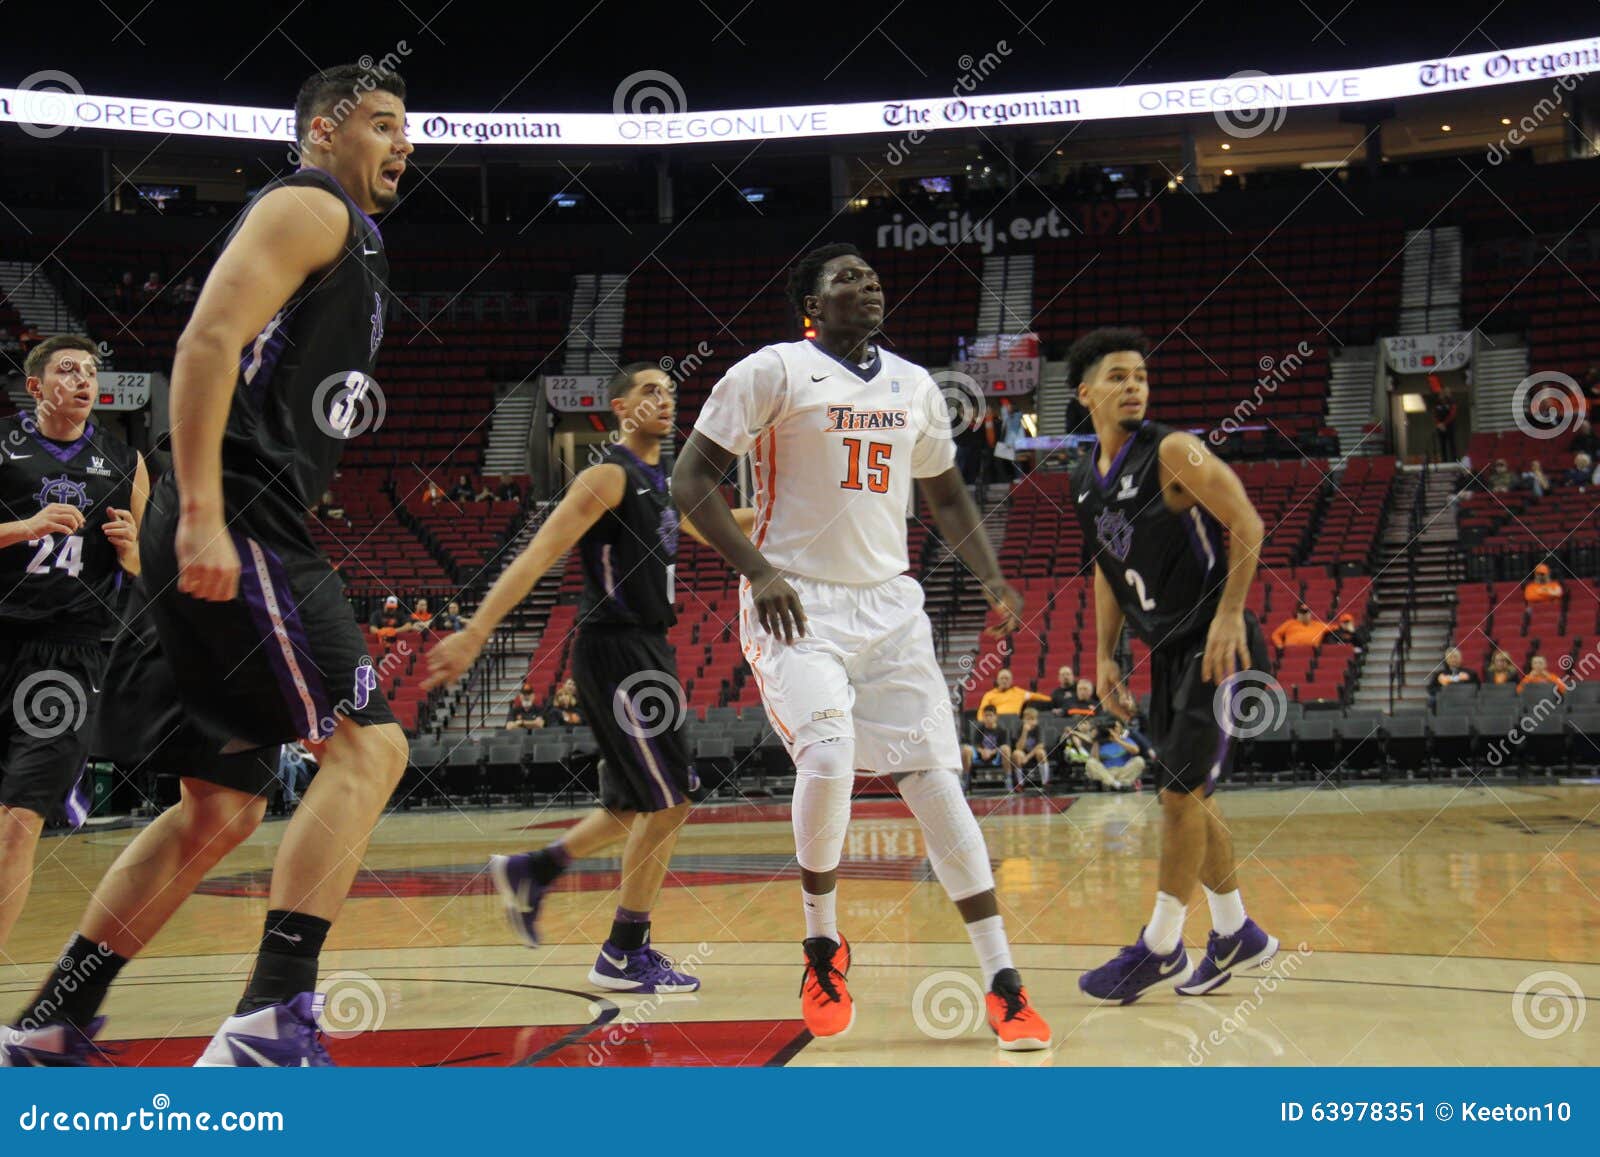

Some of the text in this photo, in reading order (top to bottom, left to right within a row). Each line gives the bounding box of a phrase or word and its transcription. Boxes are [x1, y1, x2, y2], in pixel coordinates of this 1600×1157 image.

[1420, 63, 1470, 87] The
[1139, 76, 1361, 111] OREGONLIVE
[883, 94, 1081, 126] The Oregonian
[422, 115, 562, 142] Oregonian
[618, 111, 829, 140] OREGONLIVE
[117, 374, 145, 387] 222
[552, 378, 577, 390] 222
[118, 392, 145, 406] 116
[552, 395, 578, 408] 116
[840, 437, 893, 494] 15
[26, 533, 84, 577] 24
[1125, 568, 1157, 611] 2
